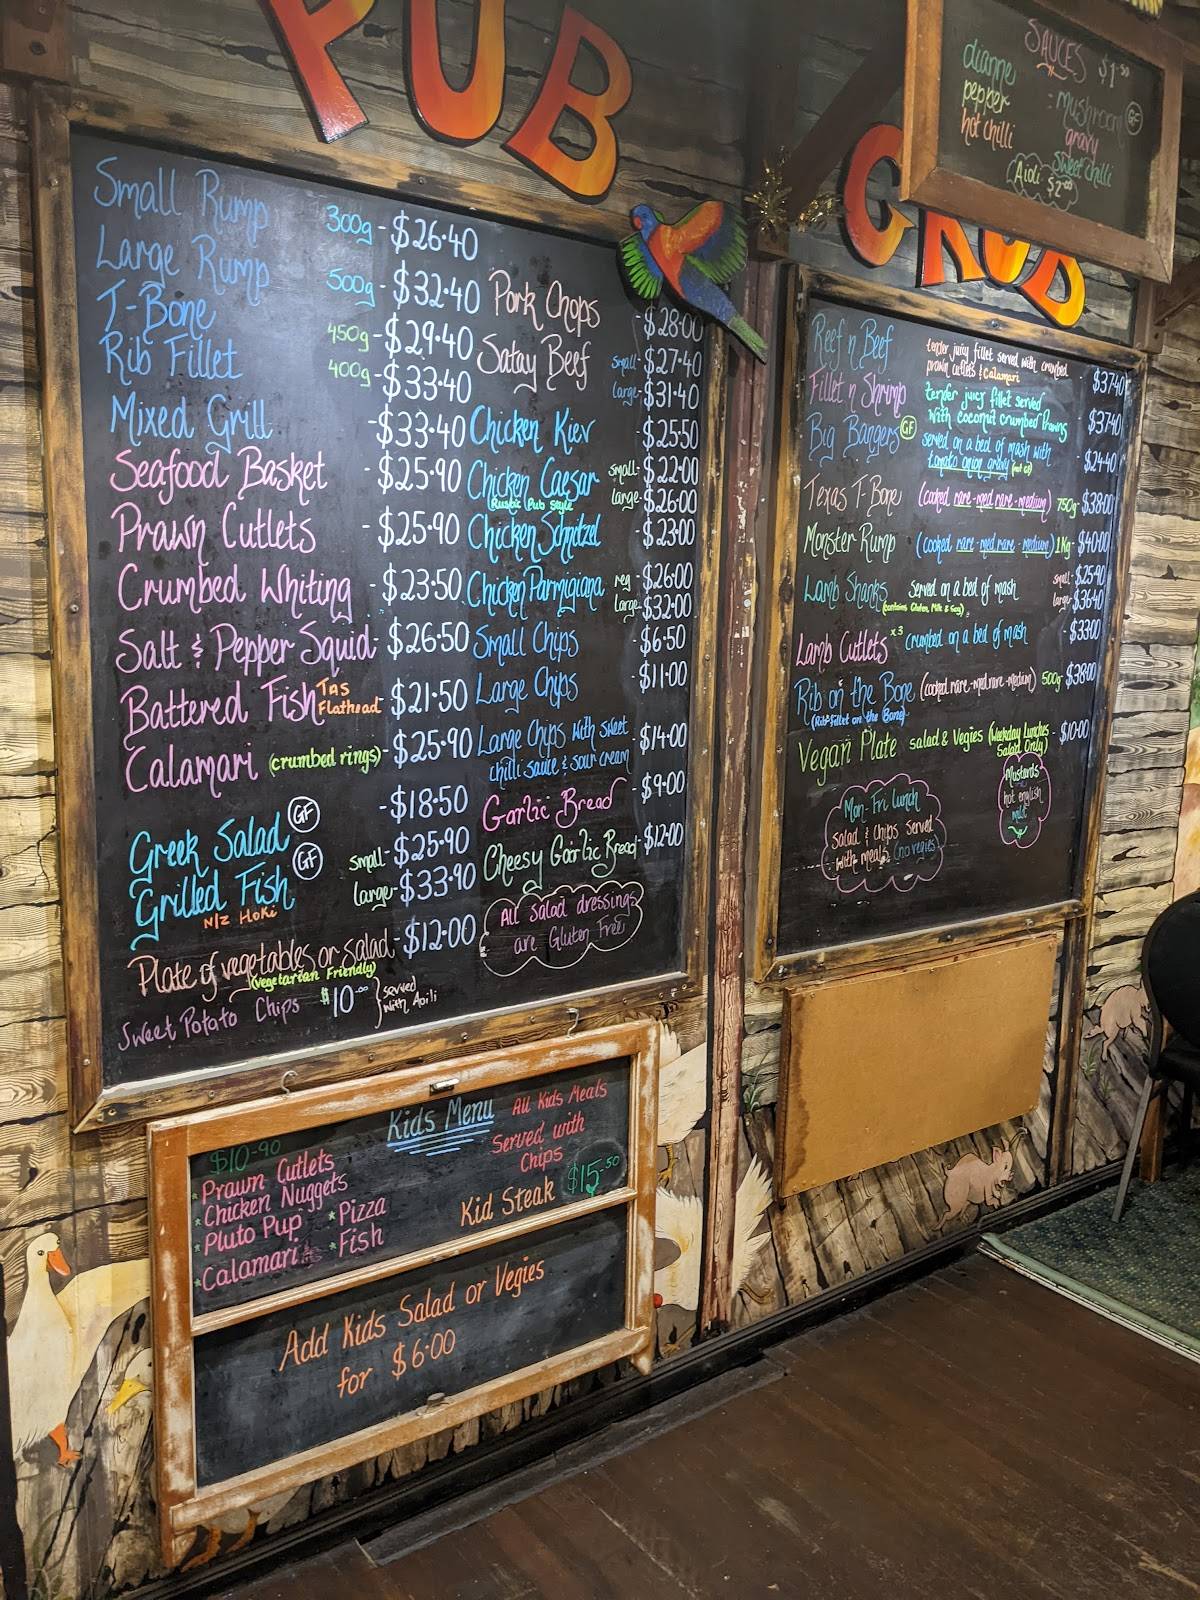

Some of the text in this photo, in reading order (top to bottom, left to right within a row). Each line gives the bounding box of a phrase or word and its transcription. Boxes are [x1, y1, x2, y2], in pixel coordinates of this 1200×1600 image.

[1025, 18, 1087, 83] SAUCES
[962, 108, 1016, 151] hot chilli
[1065, 128, 1099, 165] gravy
[94, 157, 374, 248] Small Rump 300g
[96, 224, 376, 308] Large Rump 500g
[96, 278, 369, 353] T-Bone 450g
[488, 269, 602, 338] Pork Chops
[98, 330, 371, 389] Rib Fillet 400g
[477, 333, 592, 394] Satay Beef
[811, 313, 846, 372] Reef
[859, 318, 895, 375] Beef
[809, 367, 846, 405] Fillet
[861, 371, 908, 420] Shrimp
[110, 391, 274, 455] Mixed Grill
[469, 404, 597, 456] Chicken Kiev
[806, 411, 836, 468] Big
[842, 414, 900, 465] Bangers
[109, 445, 328, 506] Seafood Basket
[467, 456, 602, 513] Chicken Caesar
[803, 472, 903, 518] Texas T-Bone
[111, 501, 317, 567] Prawn Cutlets
[467, 513, 542, 564] Chicken
[803, 522, 897, 564] Monster Rump
[118, 563, 353, 625] Crumbed Whiting
[467, 570, 529, 621] Chicken
[803, 575, 840, 610] Lamb
[845, 571, 889, 613] Shanks
[115, 620, 377, 678] Salt Pepper Squid
[472, 620, 579, 667] Small Chips
[795, 632, 833, 673] Lamb
[839, 628, 889, 665] Cutlets
[119, 674, 326, 751] Battered Fish
[475, 665, 579, 714] Large Chips
[794, 670, 916, 726] Rib on the Bone
[477, 718, 567, 766] Large Chips
[798, 736, 852, 787] Vegan
[859, 729, 898, 763] Plate
[125, 742, 260, 800] Calamari
[481, 776, 628, 832] Garlic Bread
[128, 828, 211, 900] Greek
[213, 810, 291, 863] Salad
[483, 842, 544, 896] Cheesy
[591, 828, 638, 878] Bread
[130, 868, 228, 952] Grilled
[234, 860, 296, 911] Fish
[500, 906, 520, 927] All
[513, 913, 626, 955] are Gluten Free
[127, 953, 199, 998] Plate
[200, 950, 220, 1003] of
[220, 937, 318, 1003] vegetables
[317, 942, 342, 969] or
[117, 996, 301, 1052] Sweet Potato Chips
[387, 1095, 496, 1143] Kids Menu
[511, 1078, 609, 1117] All Kids Meals
[491, 1111, 587, 1155] Served with
[519, 1145, 564, 1174] Chips
[201, 1148, 336, 1206] Prawn Cutlets
[204, 1170, 349, 1228] Chicken Nuggets
[460, 1175, 556, 1227] Kid Steak
[204, 1195, 387, 1257] Pluto Pup Pizza
[201, 1222, 385, 1293] Calamari Fish
[278, 1255, 546, 1372] Add Kids Salad or Vegies
[336, 1363, 374, 1400] for
